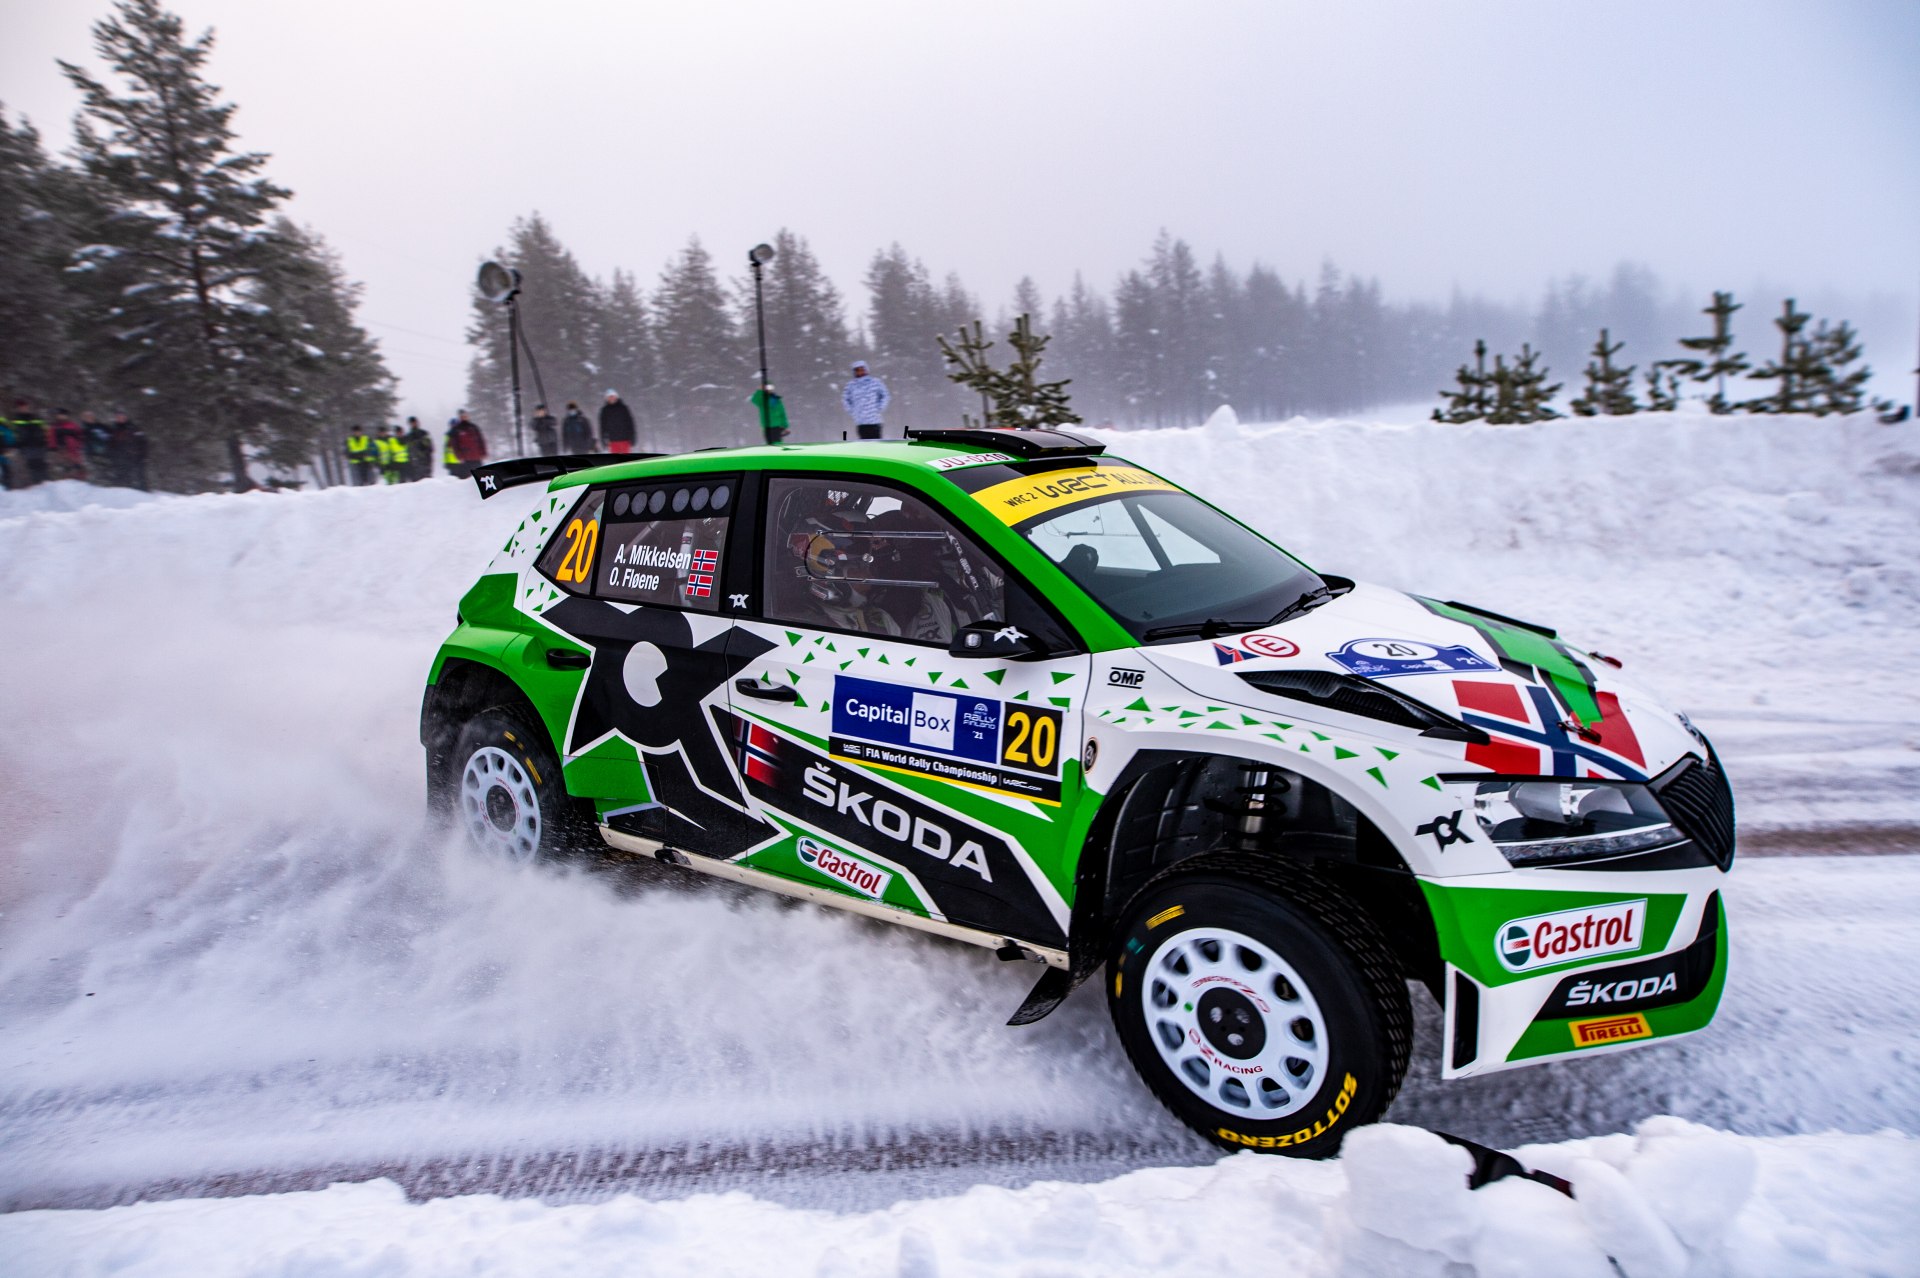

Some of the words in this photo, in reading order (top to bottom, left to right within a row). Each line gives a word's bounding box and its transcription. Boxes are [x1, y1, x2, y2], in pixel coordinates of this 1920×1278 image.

[1003, 494, 1029, 508] WRC
[1030, 492, 1039, 500] 2
[555, 518, 599, 584] 20
[614, 544, 626, 565] A.
[629, 545, 692, 570] Mikkelsen
[609, 567, 620, 587] O.
[622, 569, 660, 591] Fløene
[1252, 638, 1288, 653] E
[1372, 643, 1418, 657] 20
[1109, 670, 1145, 686] OMP
[1004, 711, 1056, 768] 20
[865, 747, 880, 759] FIA
[881, 750, 907, 764] World
[908, 756, 931, 771] Rally
[933, 761, 998, 785] Championship
[802, 762, 993, 883] ŠKODA
[816, 848, 883, 895] Castrol
[1533, 908, 1633, 959] Castrol
[1565, 971, 1678, 1007] ŠKODA
[1577, 1016, 1644, 1043] PIRELLI
[1213, 1057, 1263, 1075] RACING
[1217, 1072, 1358, 1148] SOTTOZERO
